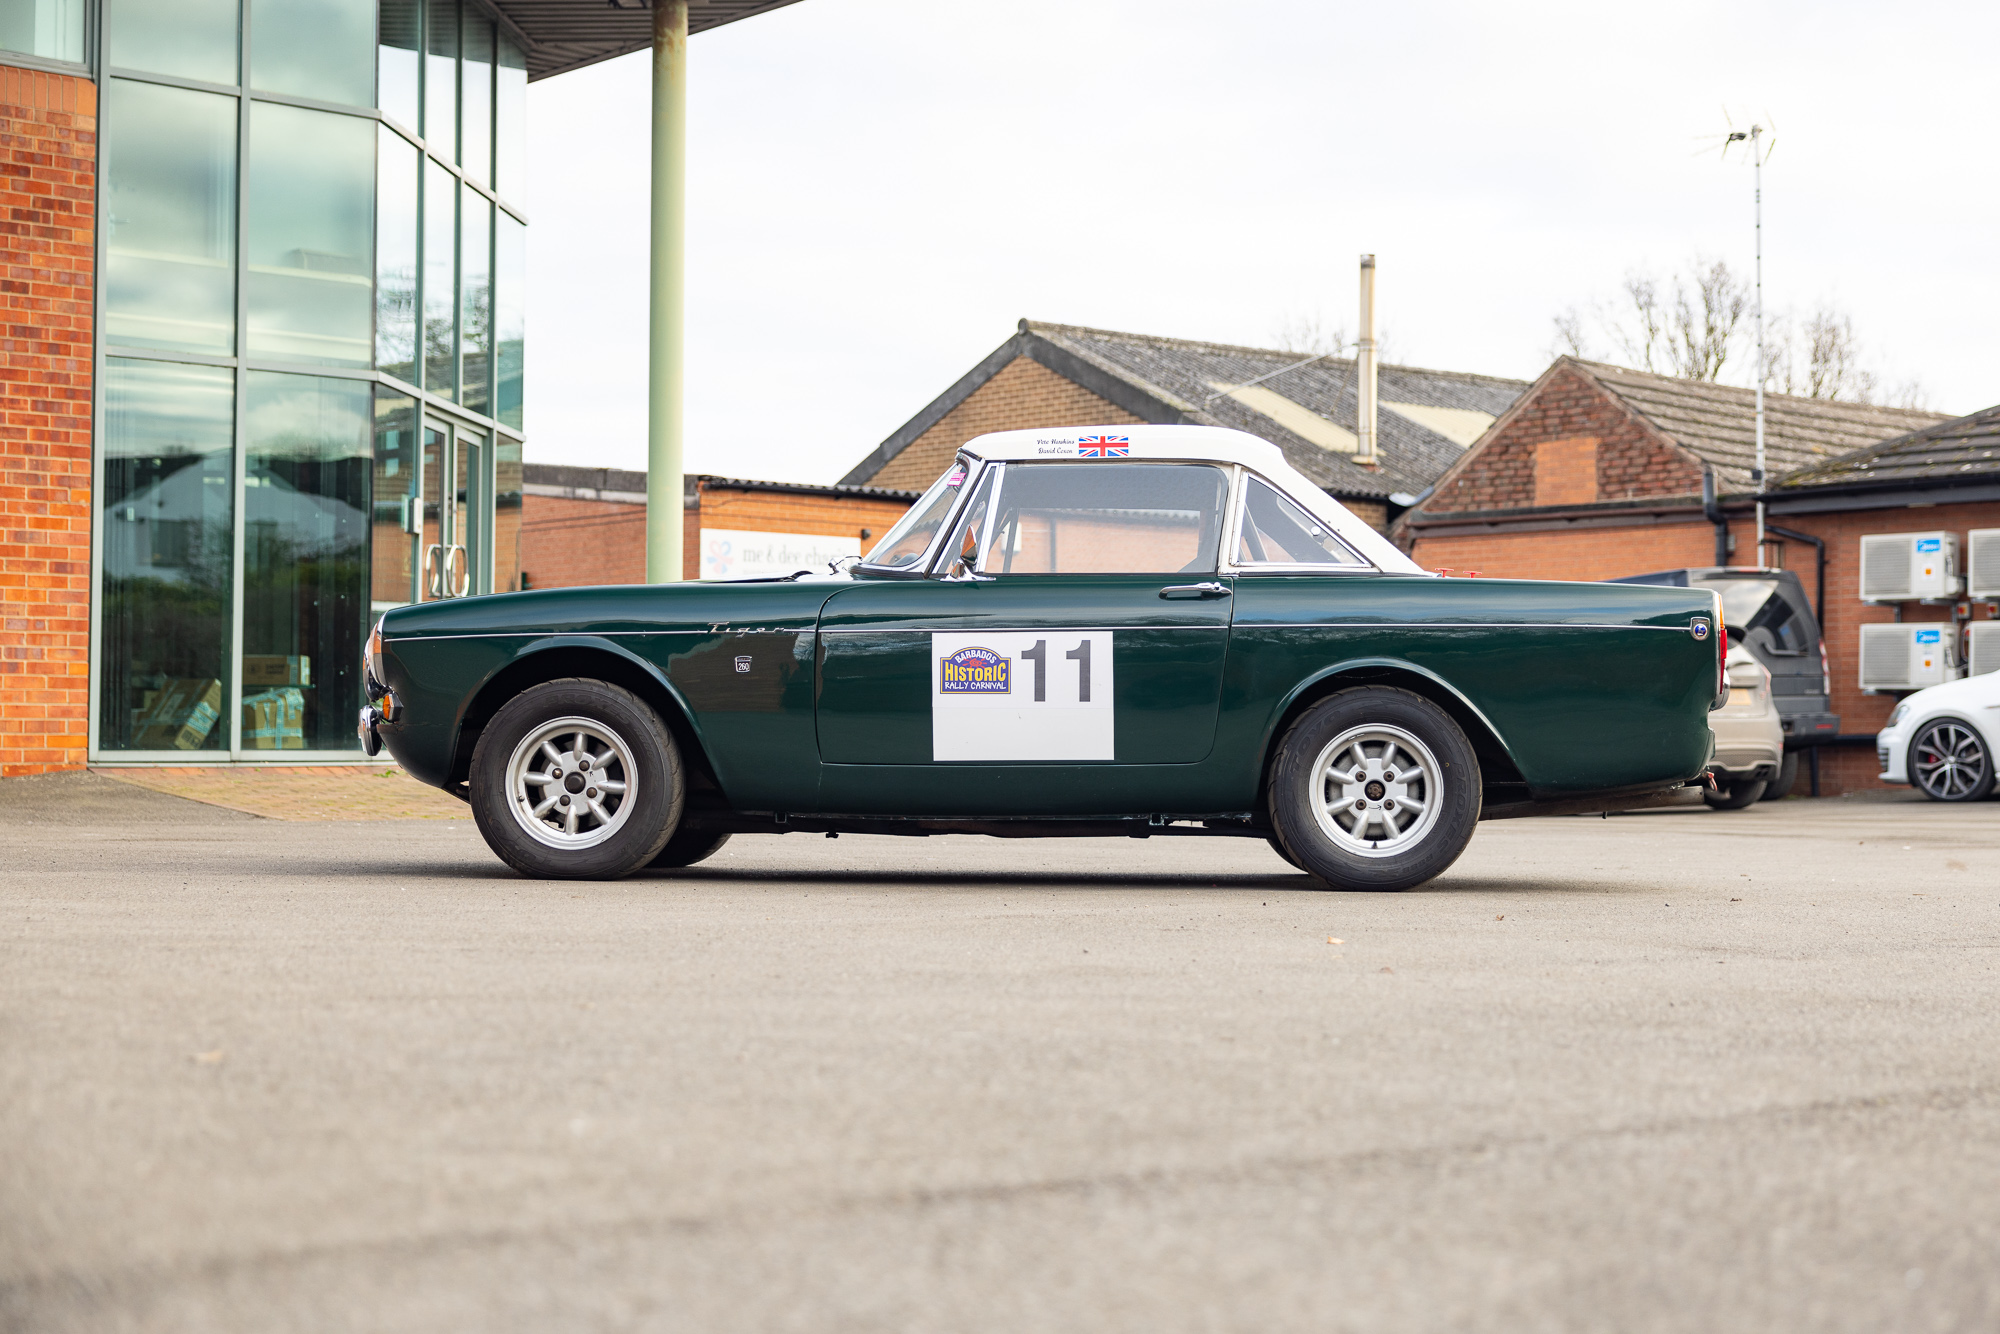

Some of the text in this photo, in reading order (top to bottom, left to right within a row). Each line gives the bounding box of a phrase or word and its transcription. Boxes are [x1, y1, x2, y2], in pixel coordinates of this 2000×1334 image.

[743, 548, 765, 563] me
[778, 544, 802, 564] dee
[708, 622, 784, 638] Tiger
[954, 650, 997, 664] BARBADOS
[738, 662, 750, 671] 260
[945, 661, 1006, 682] HISTORIC
[1021, 640, 1091, 702] 11
[945, 681, 1007, 690] RALLY CARNIVAL
[1435, 761, 1467, 854] PROXES
